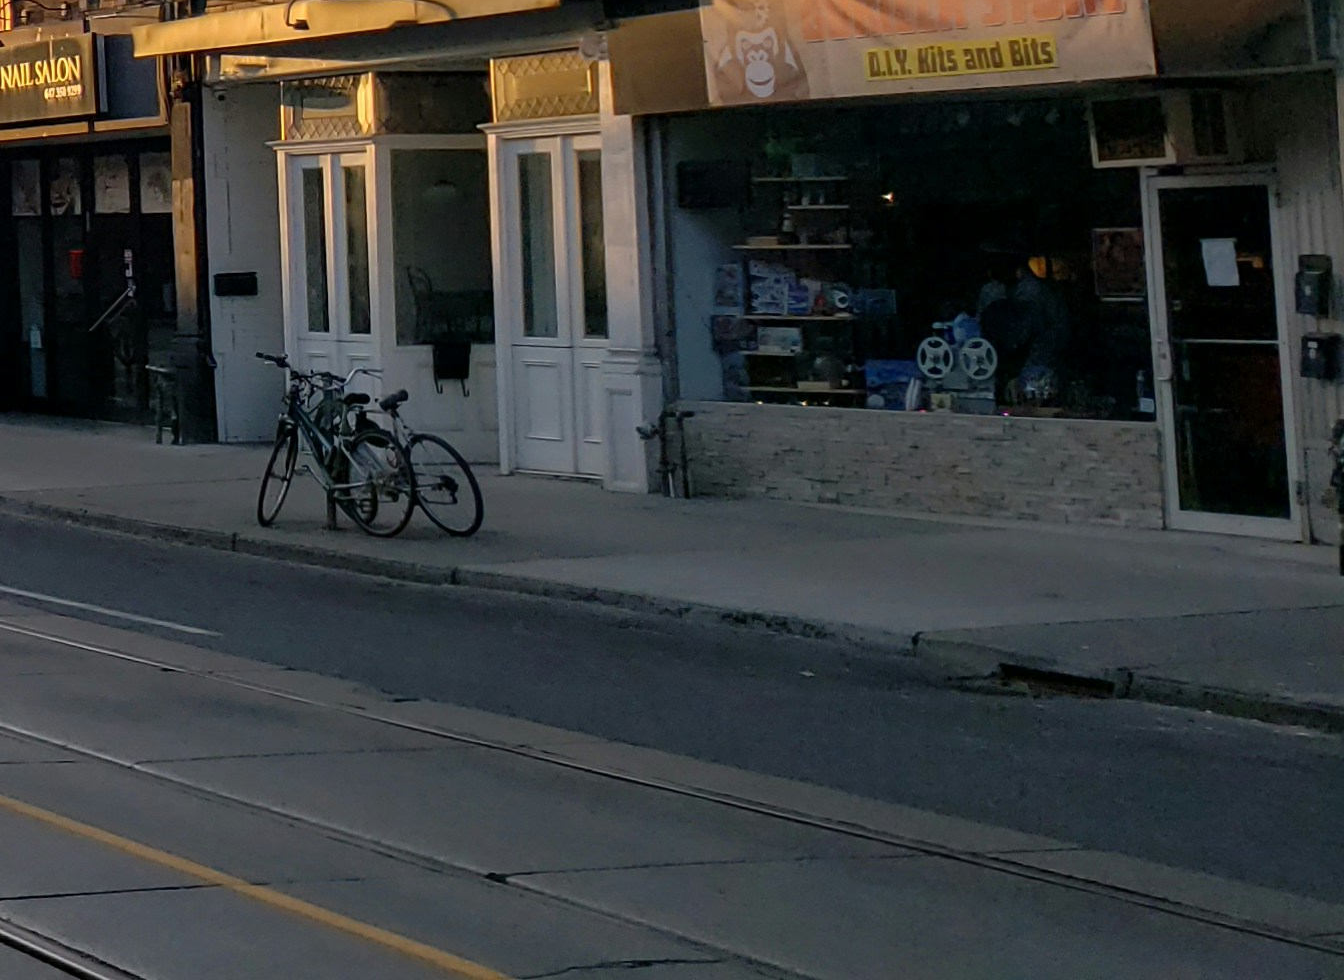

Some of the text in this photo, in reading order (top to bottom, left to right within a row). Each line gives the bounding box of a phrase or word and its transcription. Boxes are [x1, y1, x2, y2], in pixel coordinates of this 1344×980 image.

[0, 62, 34, 89] NAIL
[35, 55, 81, 85] SALON
[869, 37, 1054, 78] D.I.Y. Kits and Bits
